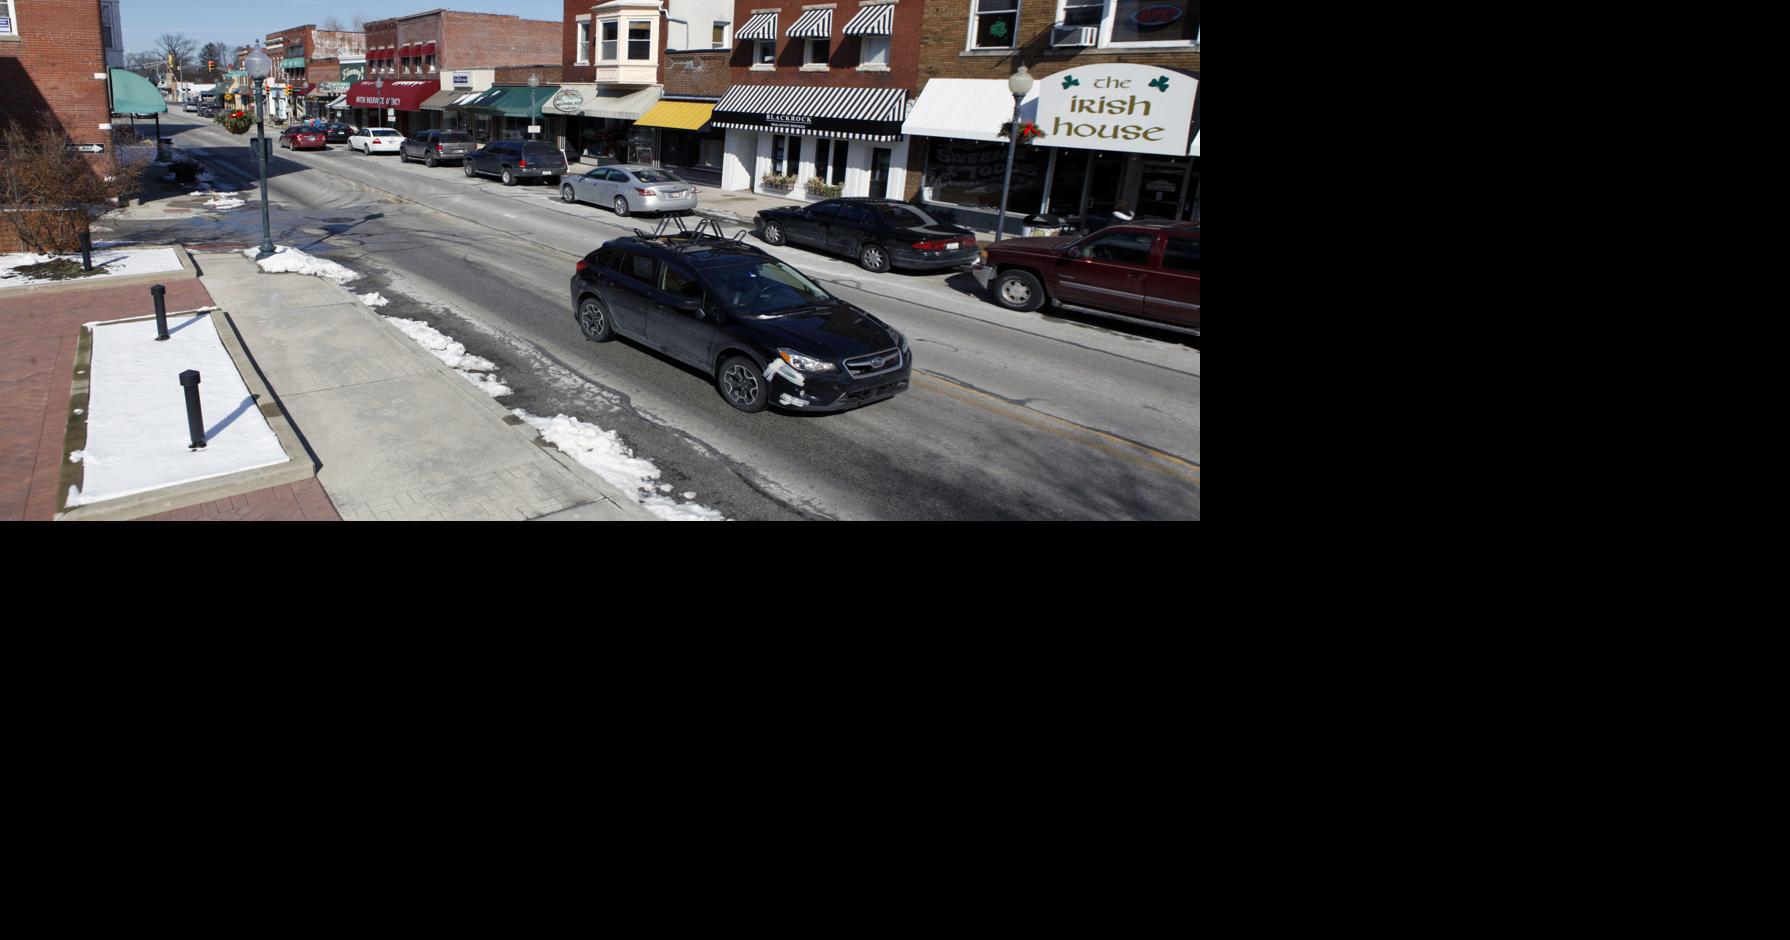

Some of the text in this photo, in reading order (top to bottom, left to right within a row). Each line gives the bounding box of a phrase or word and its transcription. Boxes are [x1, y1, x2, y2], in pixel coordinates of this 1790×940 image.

[1093, 76, 1132, 89] the
[386, 97, 400, 106] AENCY
[766, 114, 812, 123] BLACKROCK
[1053, 116, 1165, 141] house
